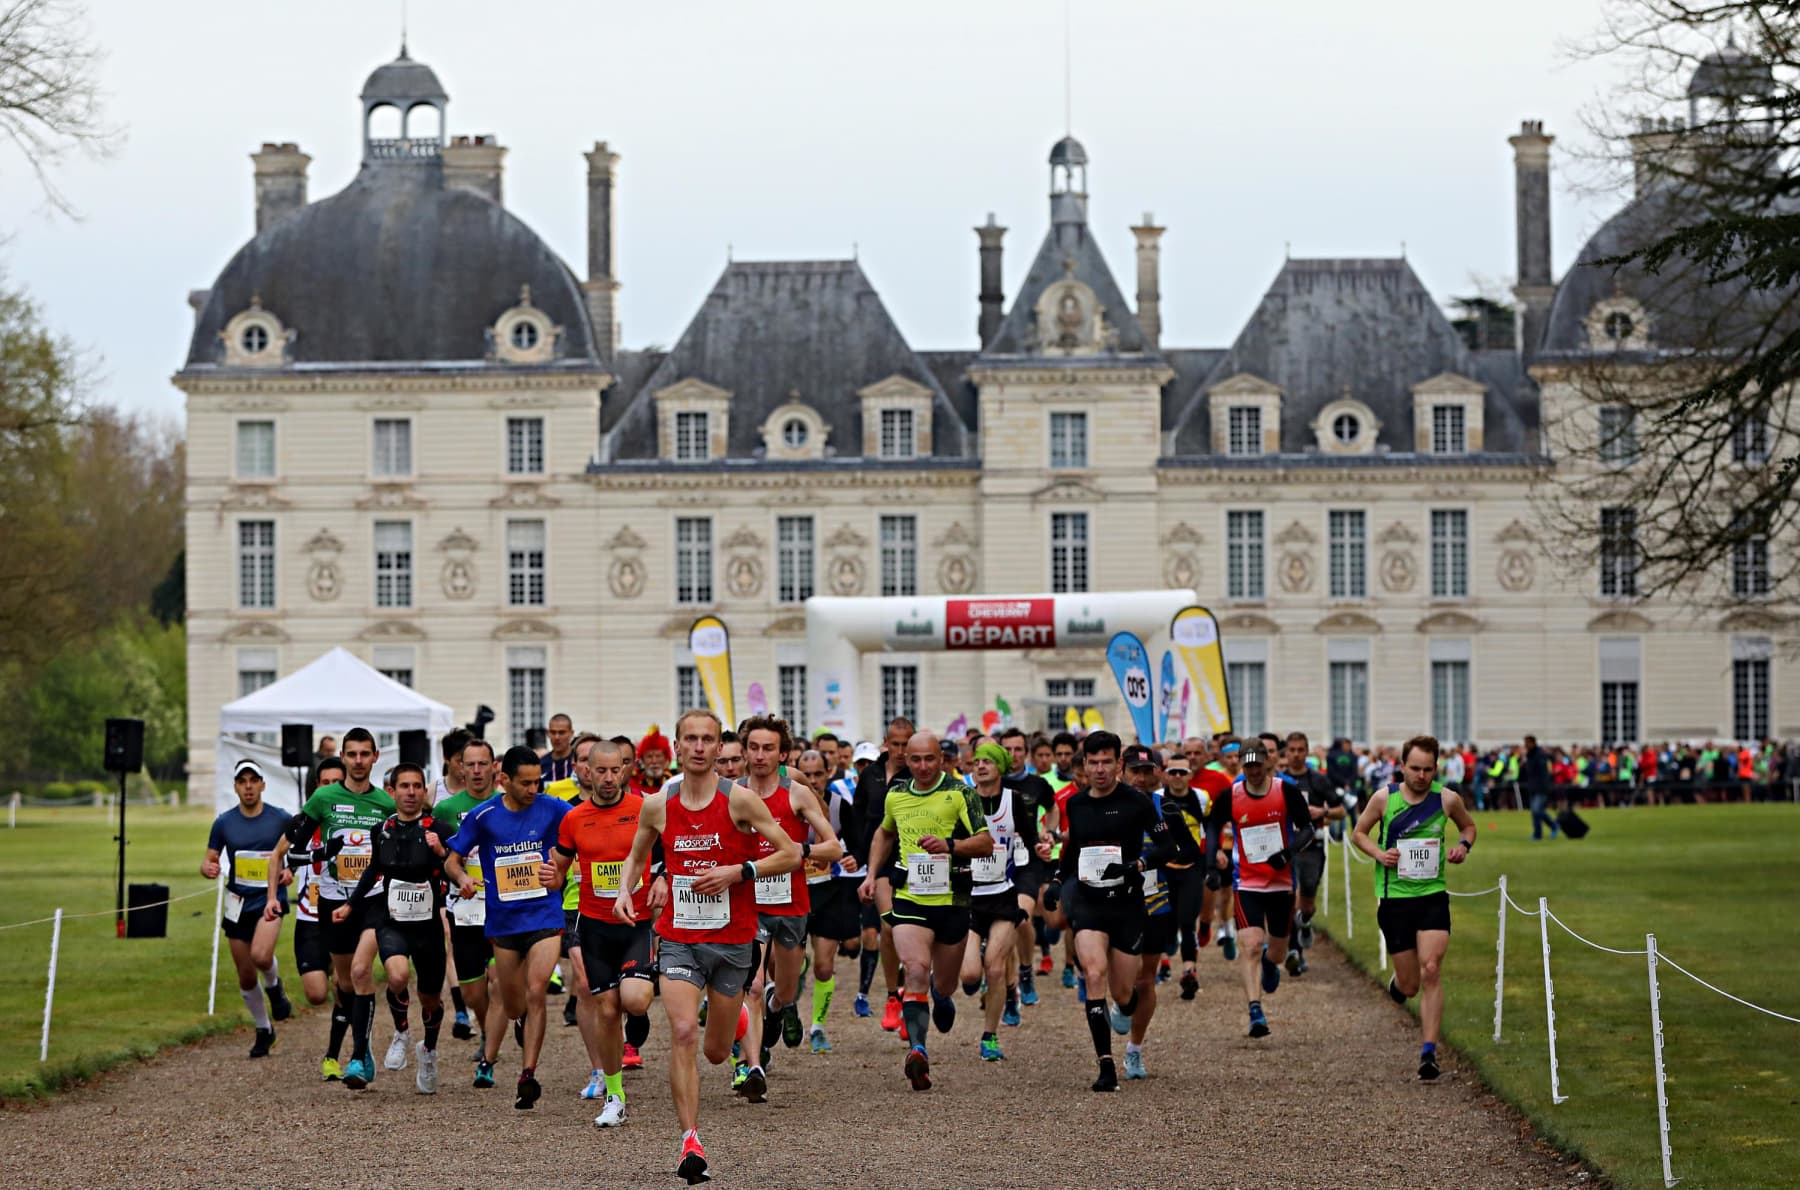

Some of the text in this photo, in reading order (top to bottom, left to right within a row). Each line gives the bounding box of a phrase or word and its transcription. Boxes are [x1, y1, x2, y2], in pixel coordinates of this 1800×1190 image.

[949, 620, 1052, 645] DÉPART
[494, 840, 543, 854] worldline
[674, 839, 713, 849] PROSPORT
[1409, 849, 1430, 860] THEO
[344, 857, 370, 868] OLIVIE
[917, 861, 935, 875] ÉLIE
[506, 865, 535, 879] JAMAL
[597, 864, 623, 877] CAMI
[755, 871, 786, 883] DOVIC
[765, 884, 770, 892] 3
[397, 890, 425, 902] JULIEN
[679, 889, 723, 904] ANTOINE
[408, 903, 413, 911] 2
[697, 905, 702, 914] 1
